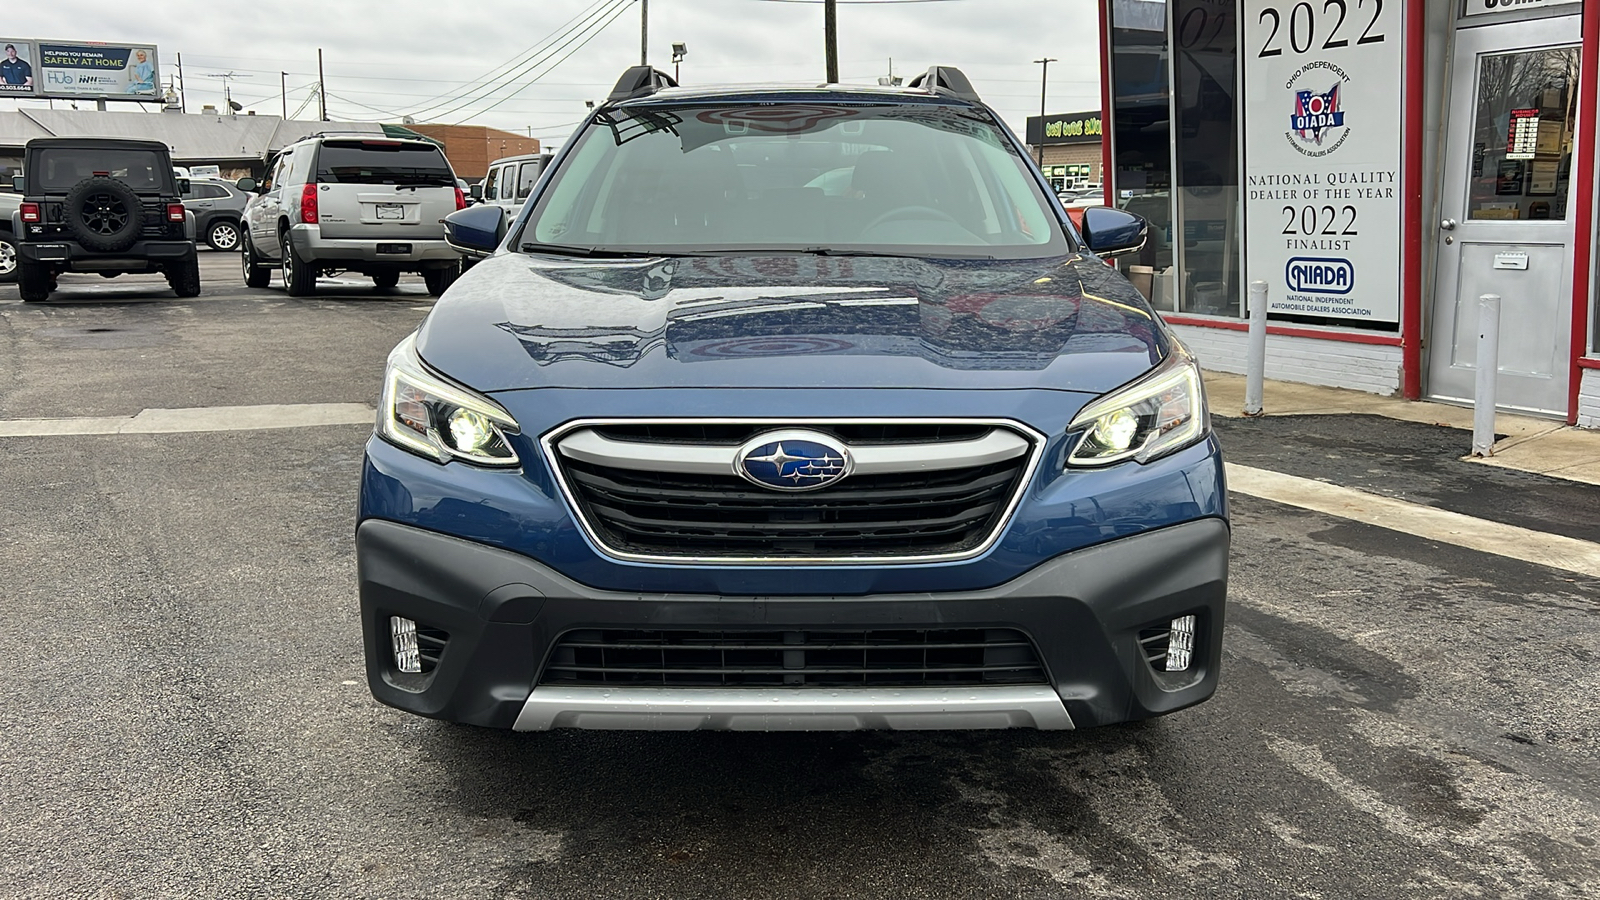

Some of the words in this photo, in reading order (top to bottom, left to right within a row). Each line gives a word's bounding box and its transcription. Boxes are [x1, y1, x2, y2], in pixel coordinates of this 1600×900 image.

[1258, 0, 1385, 58] 2022
[44, 56, 79, 65] SAFELY
[1286, 70, 1302, 90] OHIO
[1302, 61, 1350, 83] INDEPENDENT
[1297, 113, 1335, 128] OIADA
[1285, 132, 1306, 156] AUTOMOBILE
[1307, 149, 1327, 157] DEALERS
[1327, 127, 1351, 154] ASSOCIATION
[1249, 174, 1320, 186] NATIONAL
[1327, 171, 1396, 186] QUALITY
[1250, 190, 1298, 200] DEALER
[1303, 189, 1319, 199] OF
[1325, 189, 1351, 199] THE
[1357, 188, 1393, 199] YEAR
[1282, 205, 1358, 236] 2022
[1287, 239, 1351, 250] FINALIST
[1291, 265, 1347, 287] NIADA
[1315, 296, 1354, 305] INDEPENDENT
[1272, 303, 1305, 311] AUTOMOBILE
[1307, 305, 1330, 313] DEALERS
[1332, 306, 1371, 316] ASSOCIATION
